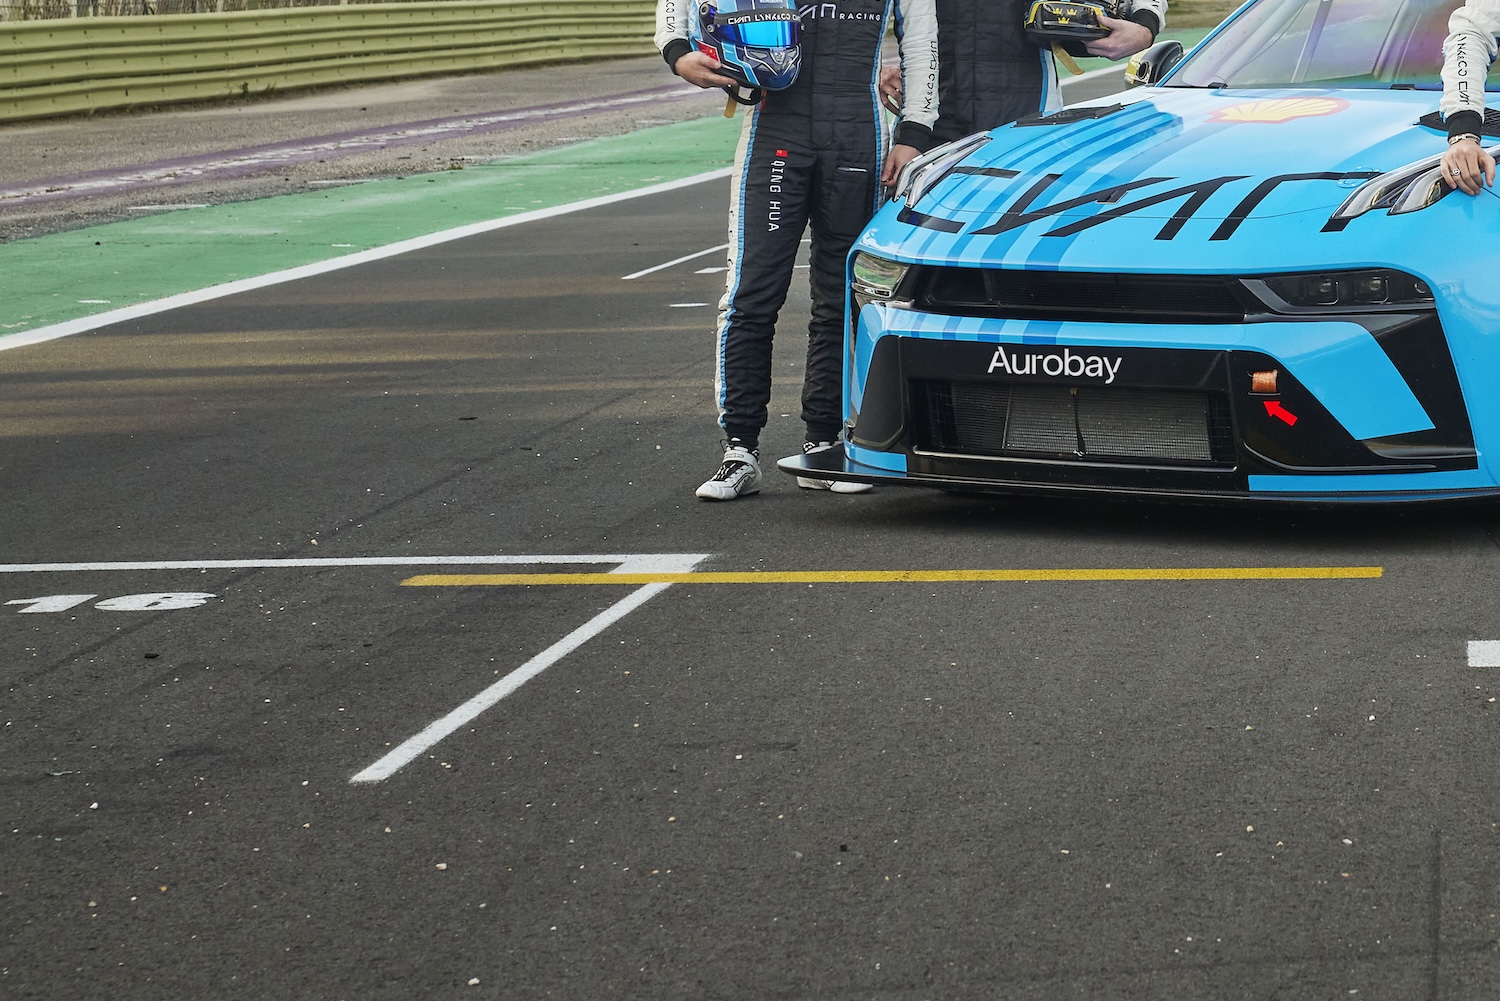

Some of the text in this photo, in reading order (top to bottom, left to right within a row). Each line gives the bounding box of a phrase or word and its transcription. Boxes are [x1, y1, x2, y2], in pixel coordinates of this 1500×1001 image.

[839, 12, 881, 22] RACING
[768, 160, 786, 232] QING HUA
[987, 346, 1122, 384] Aurobay
